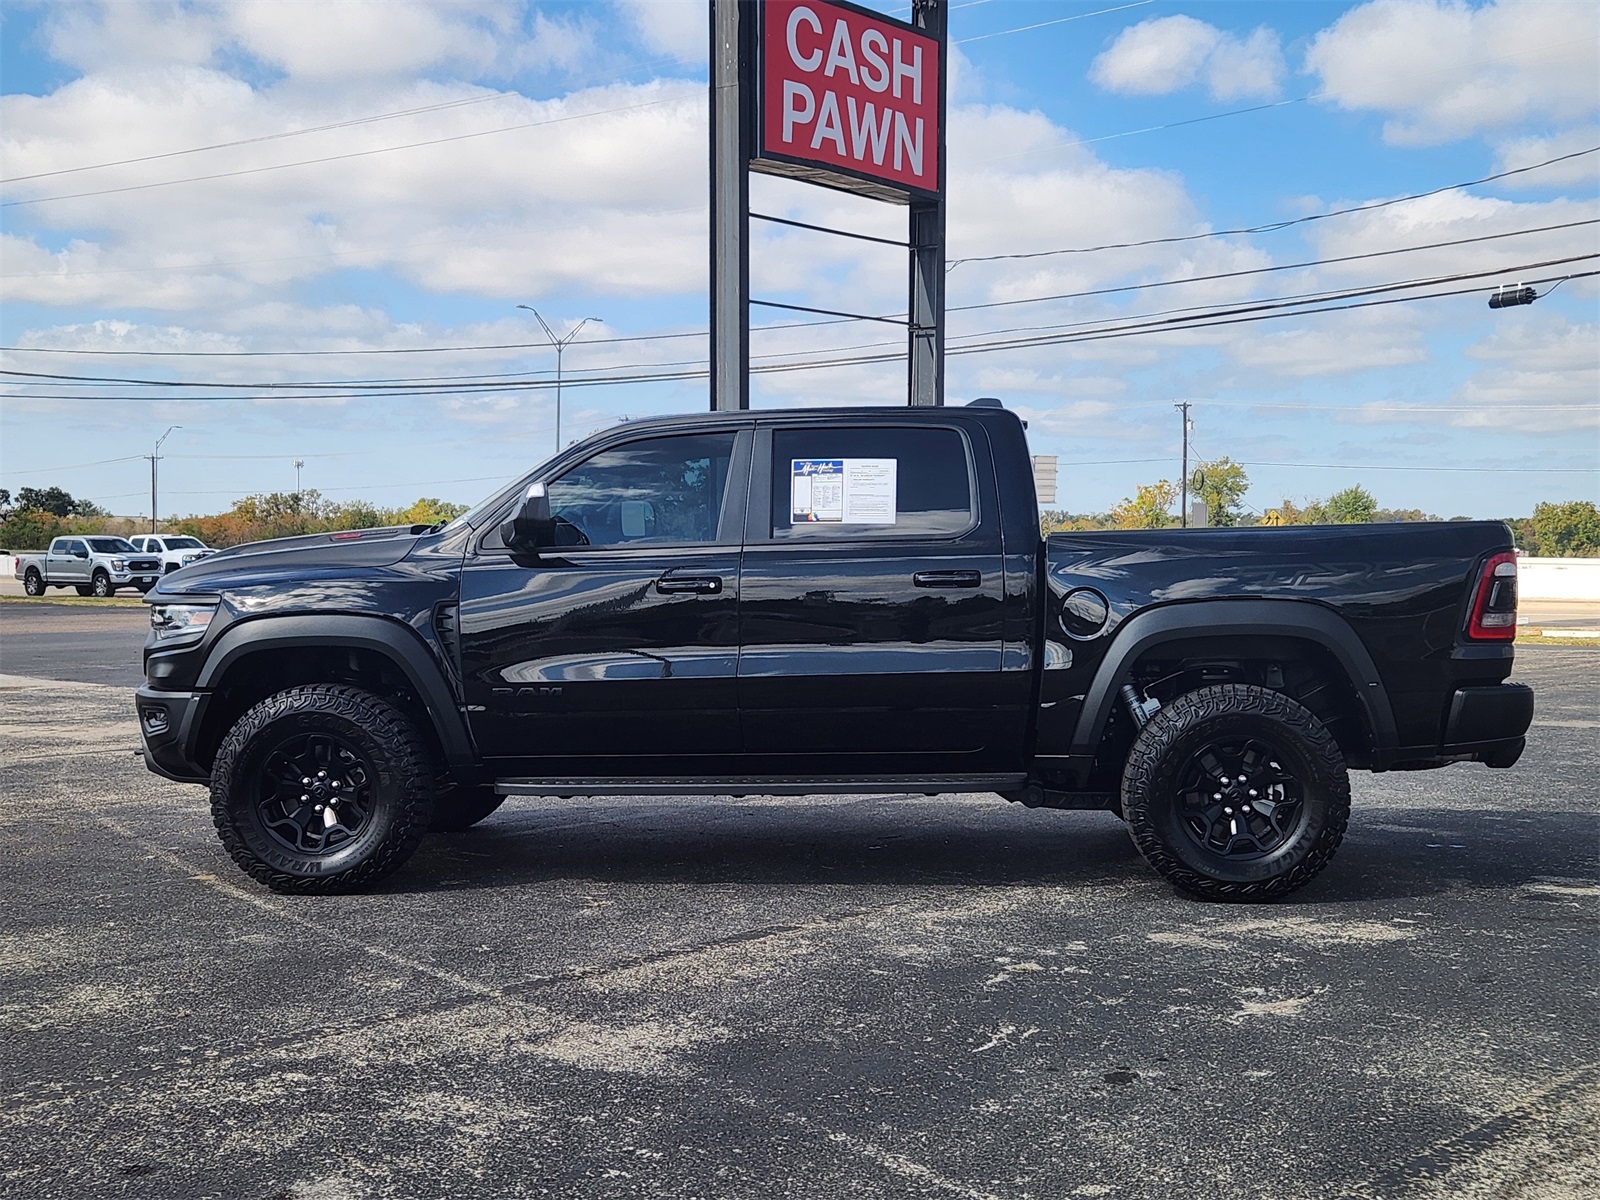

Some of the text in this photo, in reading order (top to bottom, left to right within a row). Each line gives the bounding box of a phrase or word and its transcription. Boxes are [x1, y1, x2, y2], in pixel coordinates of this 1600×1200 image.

[786, 6, 922, 105] CASH
[782, 79, 923, 177] PAWN
[492, 687, 563, 697] RAM
[297, 714, 390, 786] GOODYEAR
